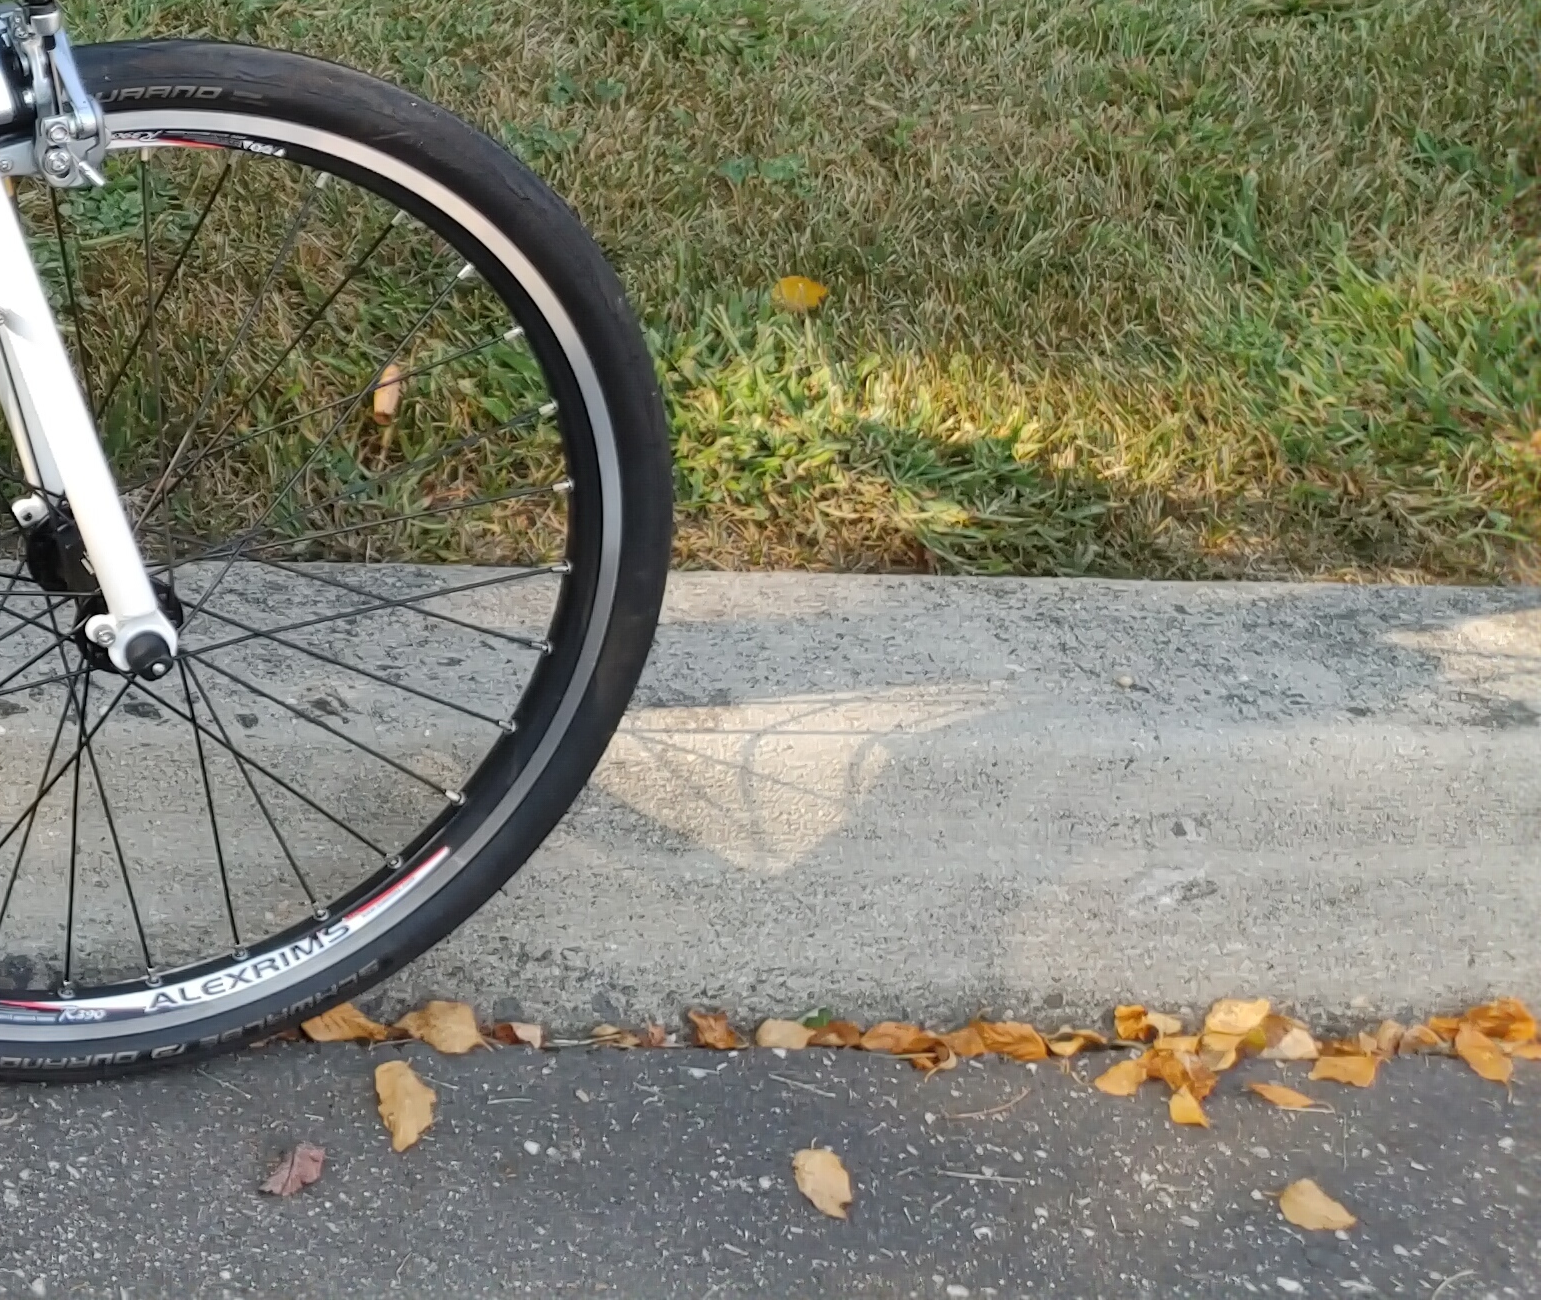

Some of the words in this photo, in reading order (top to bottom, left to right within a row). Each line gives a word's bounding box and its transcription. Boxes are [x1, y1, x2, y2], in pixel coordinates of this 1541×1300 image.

[97, 85, 222, 104] URANO
[145, 924, 350, 1012] ALEXRIMS
[58, 1004, 107, 1023] R390
